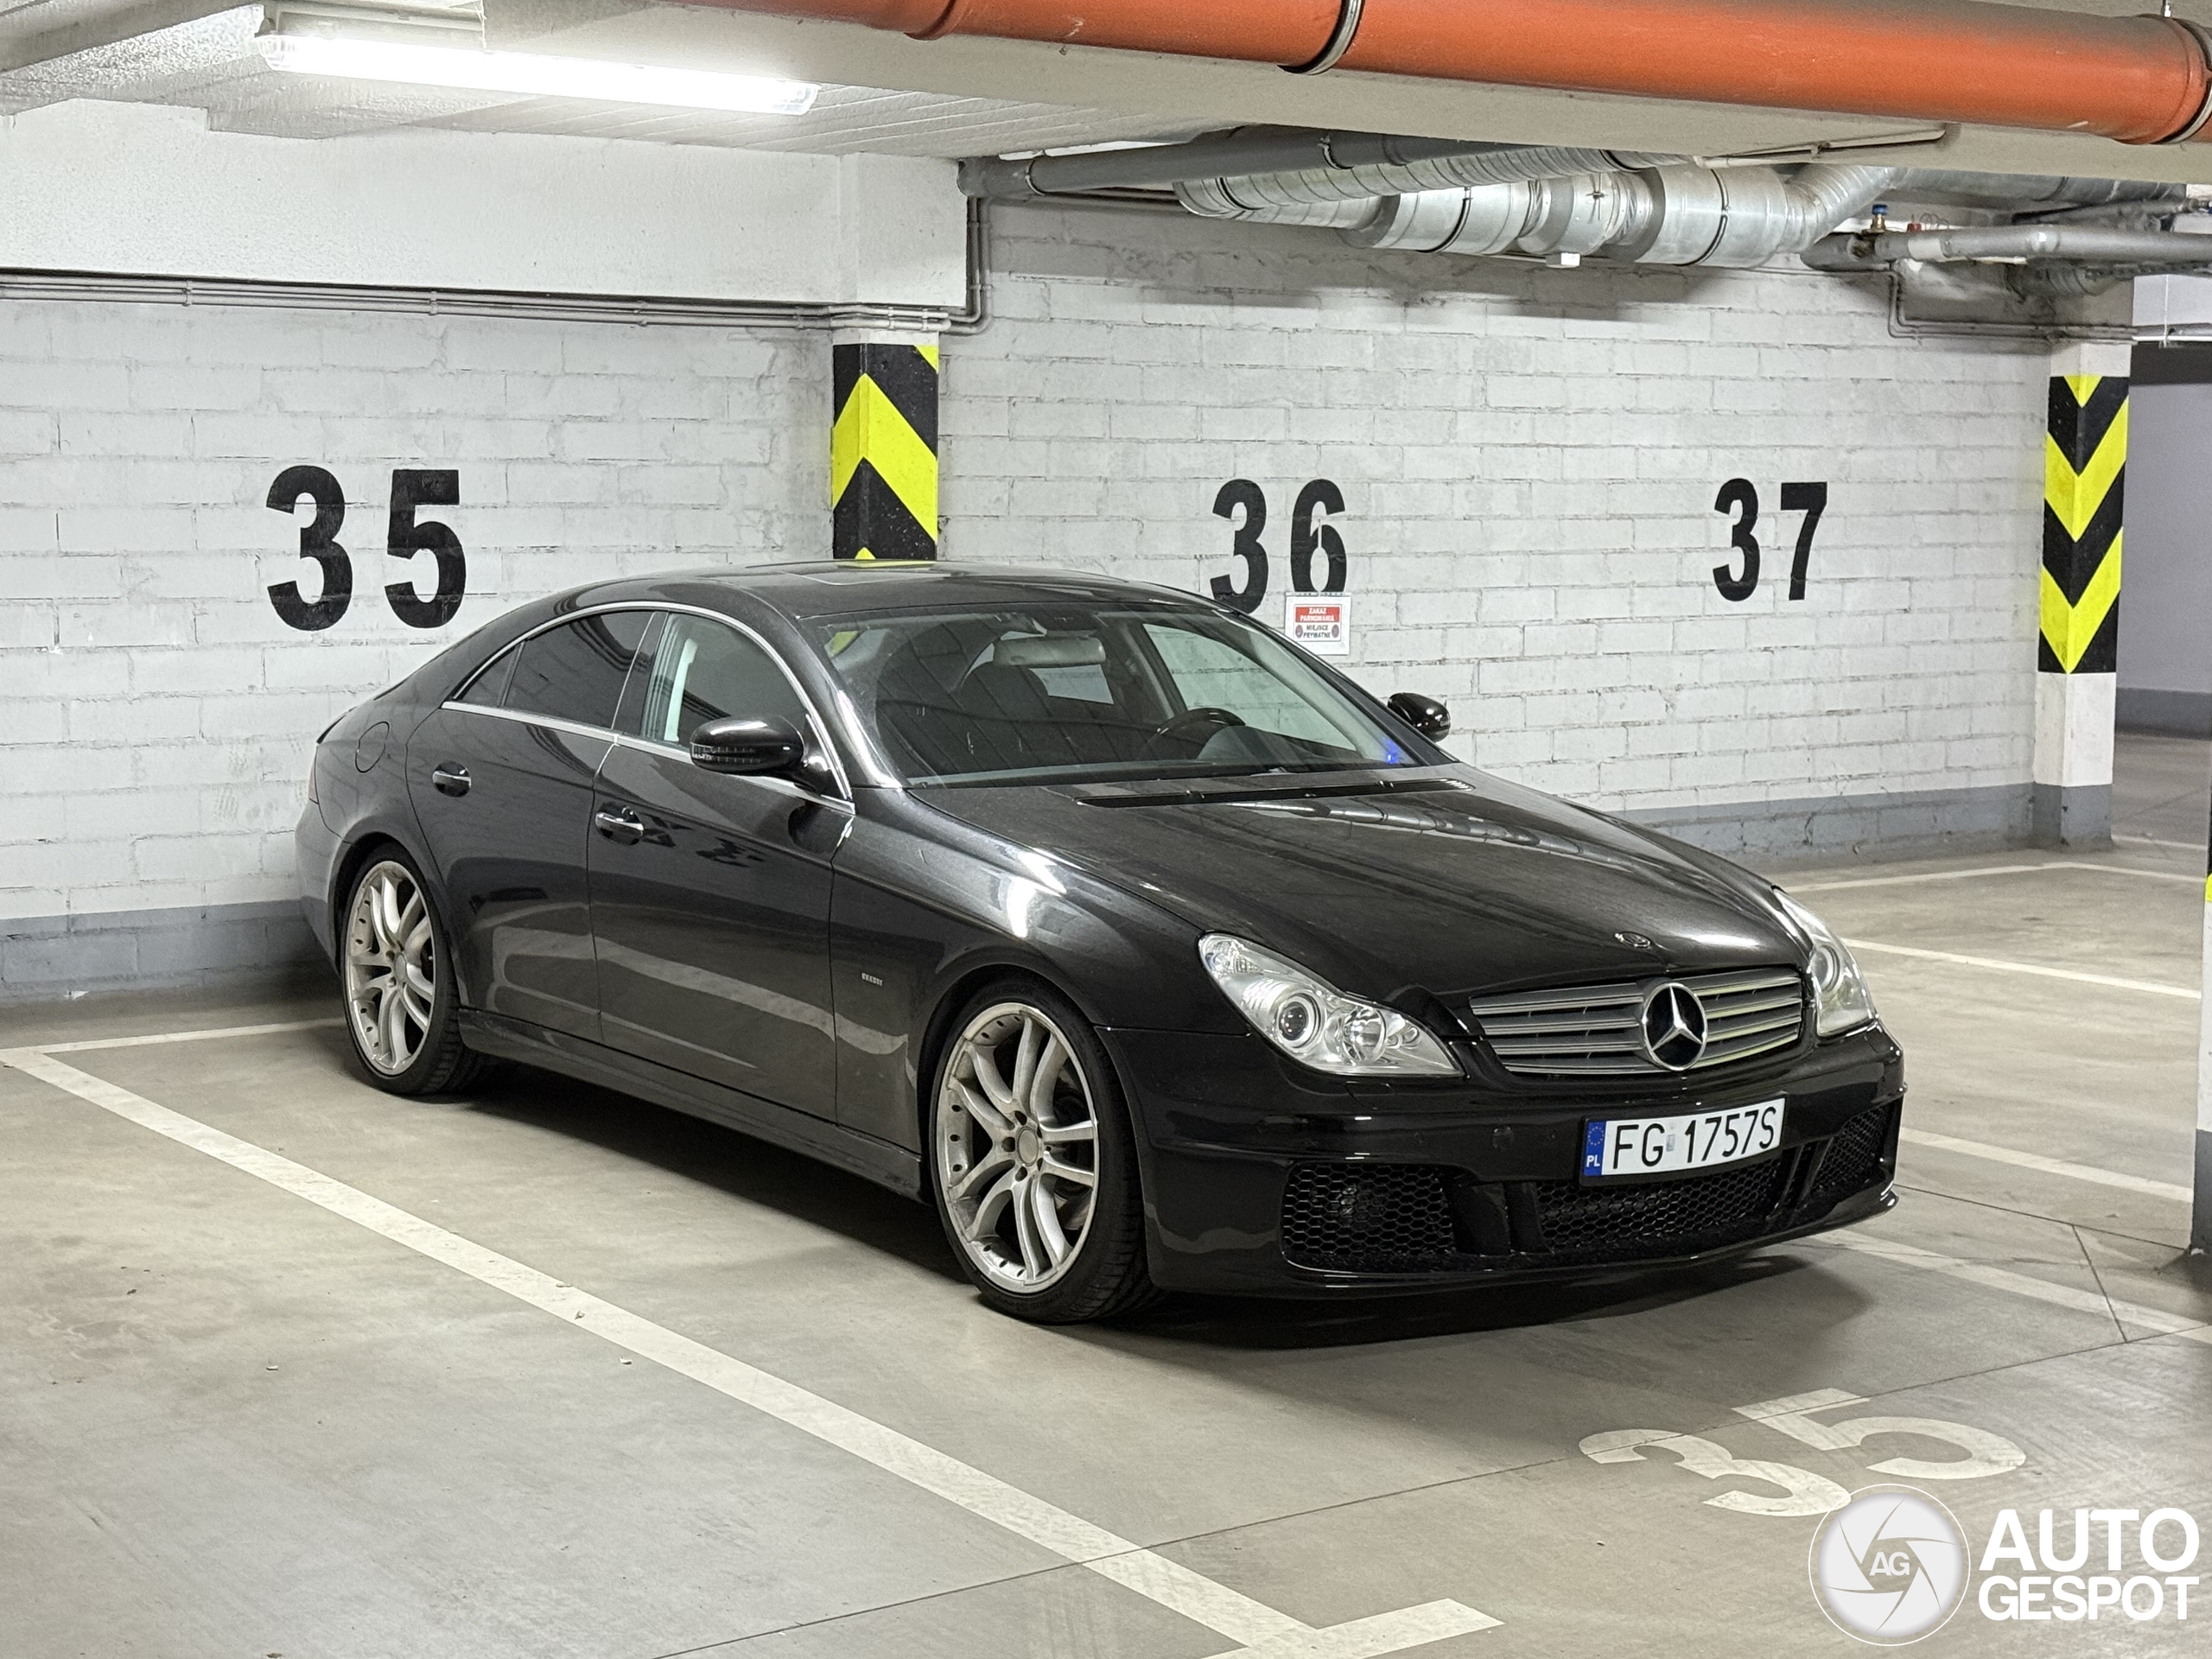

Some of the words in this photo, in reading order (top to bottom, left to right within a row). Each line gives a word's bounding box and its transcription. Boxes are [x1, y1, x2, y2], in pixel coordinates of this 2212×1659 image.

[266, 466, 466, 632] 35
[1211, 479, 1347, 614] 36
[1713, 478, 1828, 602] 37
[1586, 1154, 1601, 1167] PL
[1612, 1122, 1666, 1170] FG
[1684, 1106, 1777, 1164] 1757S
[1579, 1388, 2027, 1517] 35
